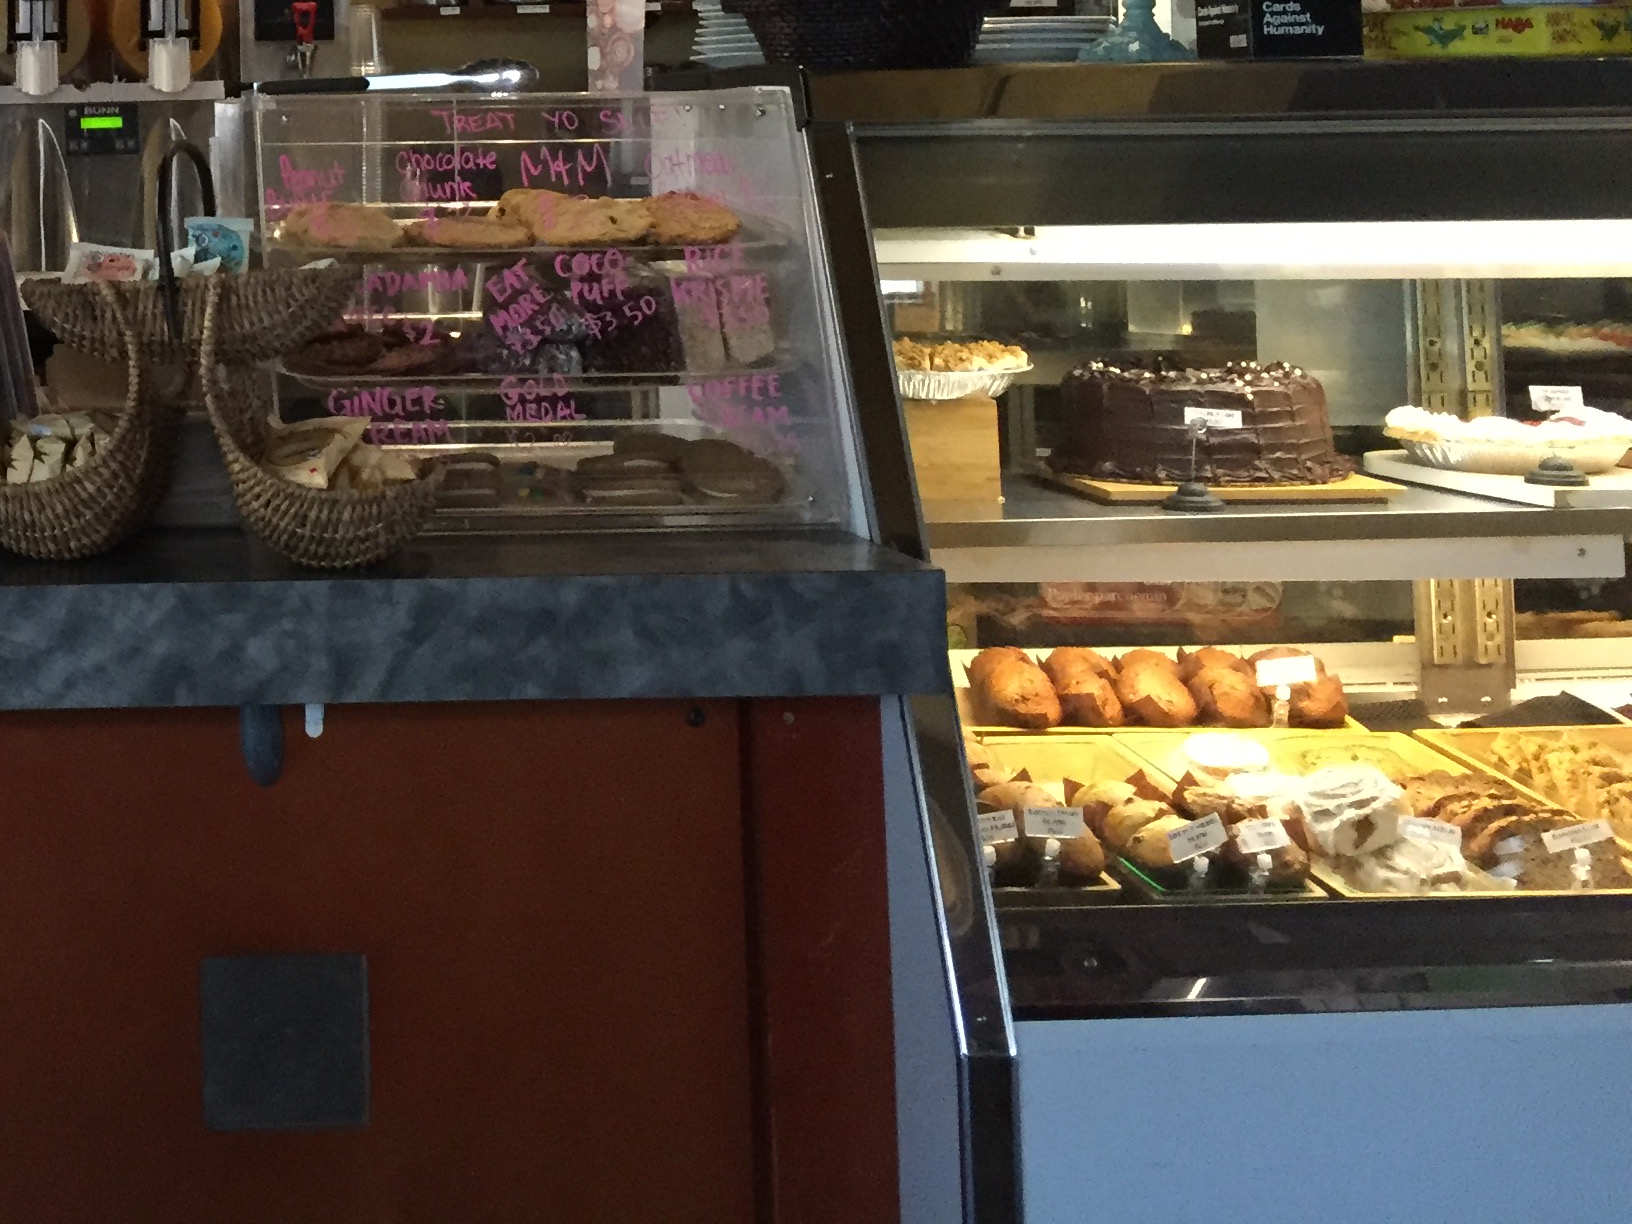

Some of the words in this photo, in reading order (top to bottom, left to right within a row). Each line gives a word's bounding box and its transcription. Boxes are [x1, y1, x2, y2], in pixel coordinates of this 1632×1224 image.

[1263, 1, 1301, 12] Cards
[1264, 13, 1311, 25] Against
[1264, 25, 1324, 36] Humanity
[84, 106, 120, 114] BUNN
[431, 109, 515, 134] TREAT
[541, 111, 578, 130] YO
